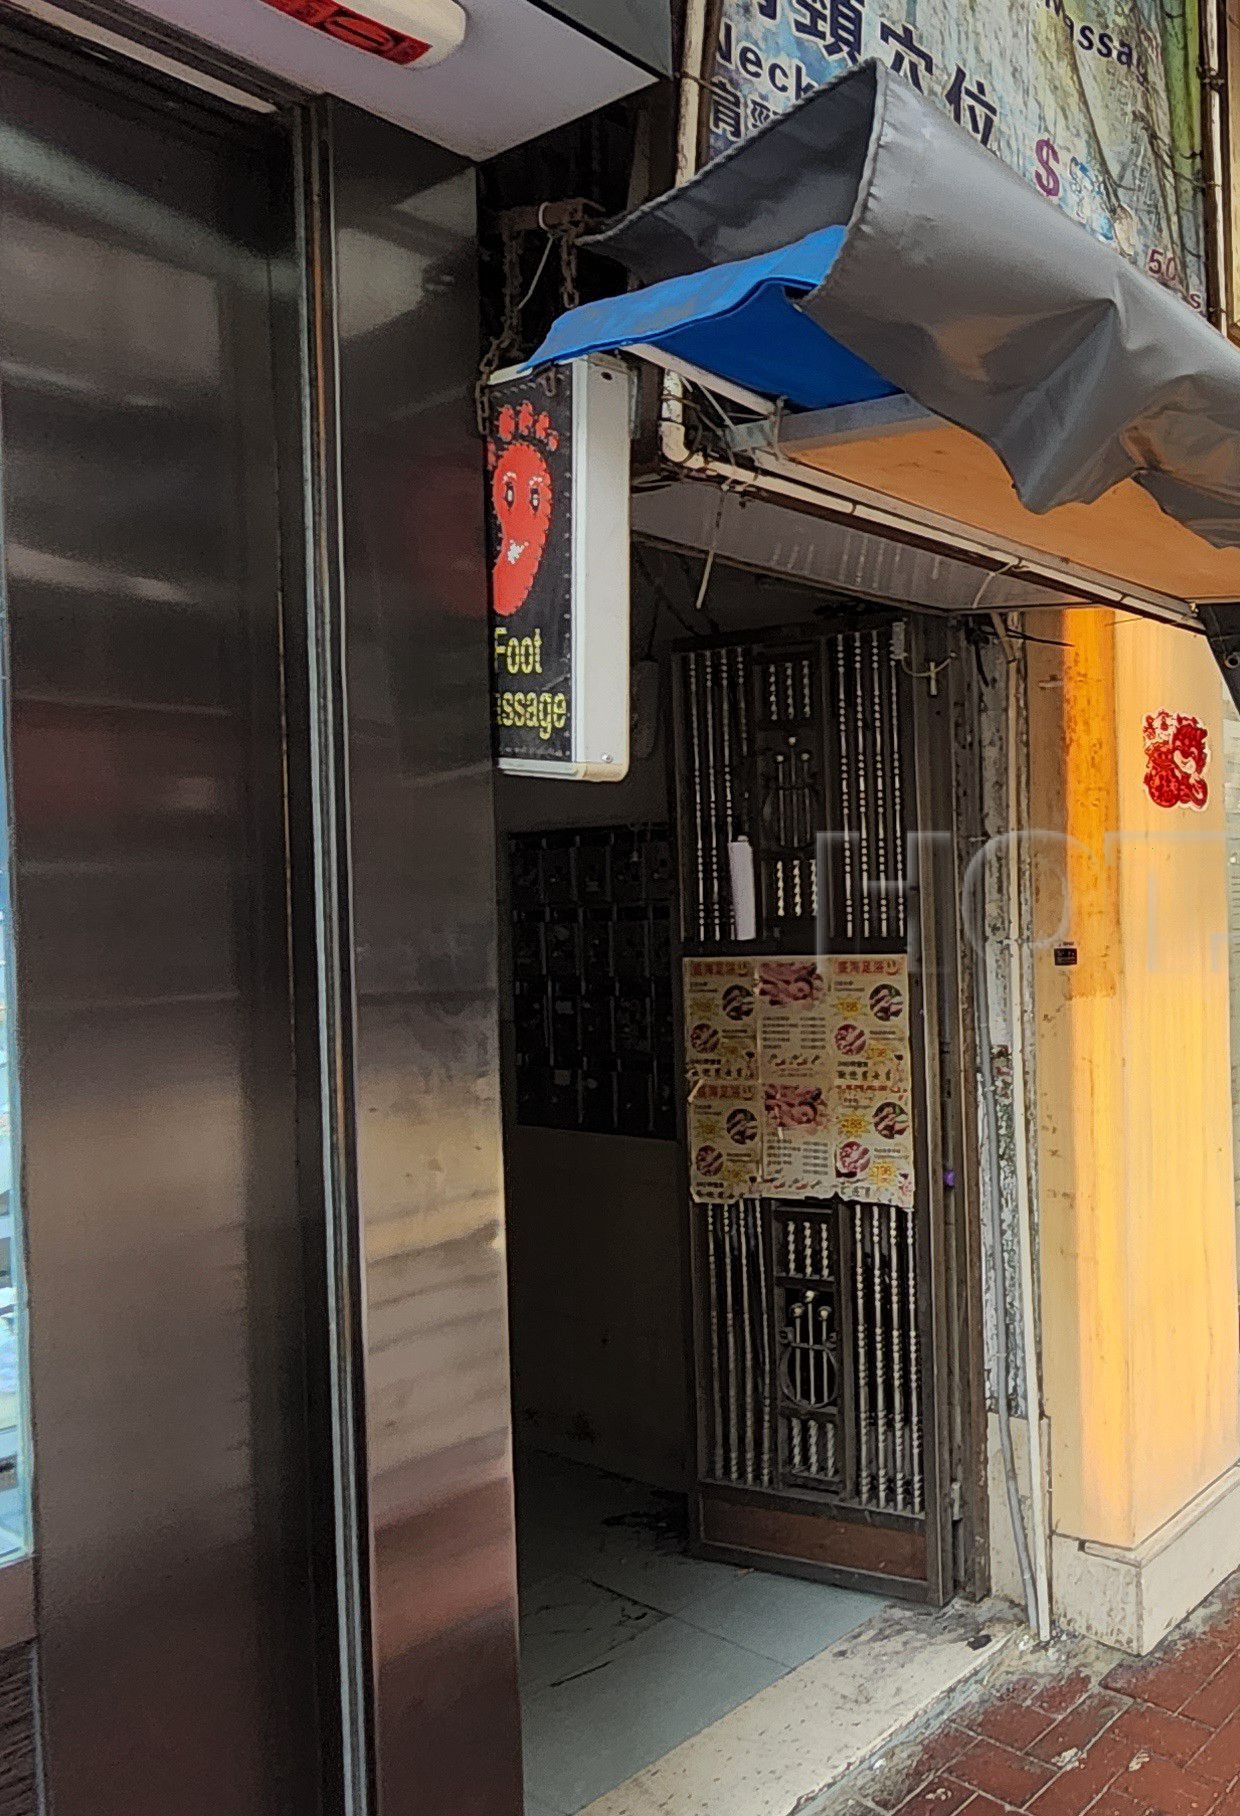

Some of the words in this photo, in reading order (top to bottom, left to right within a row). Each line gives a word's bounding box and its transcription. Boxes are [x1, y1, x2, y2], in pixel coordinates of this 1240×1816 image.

[758, 0, 998, 147] 頸穴位
[494, 627, 543, 674] Foot
